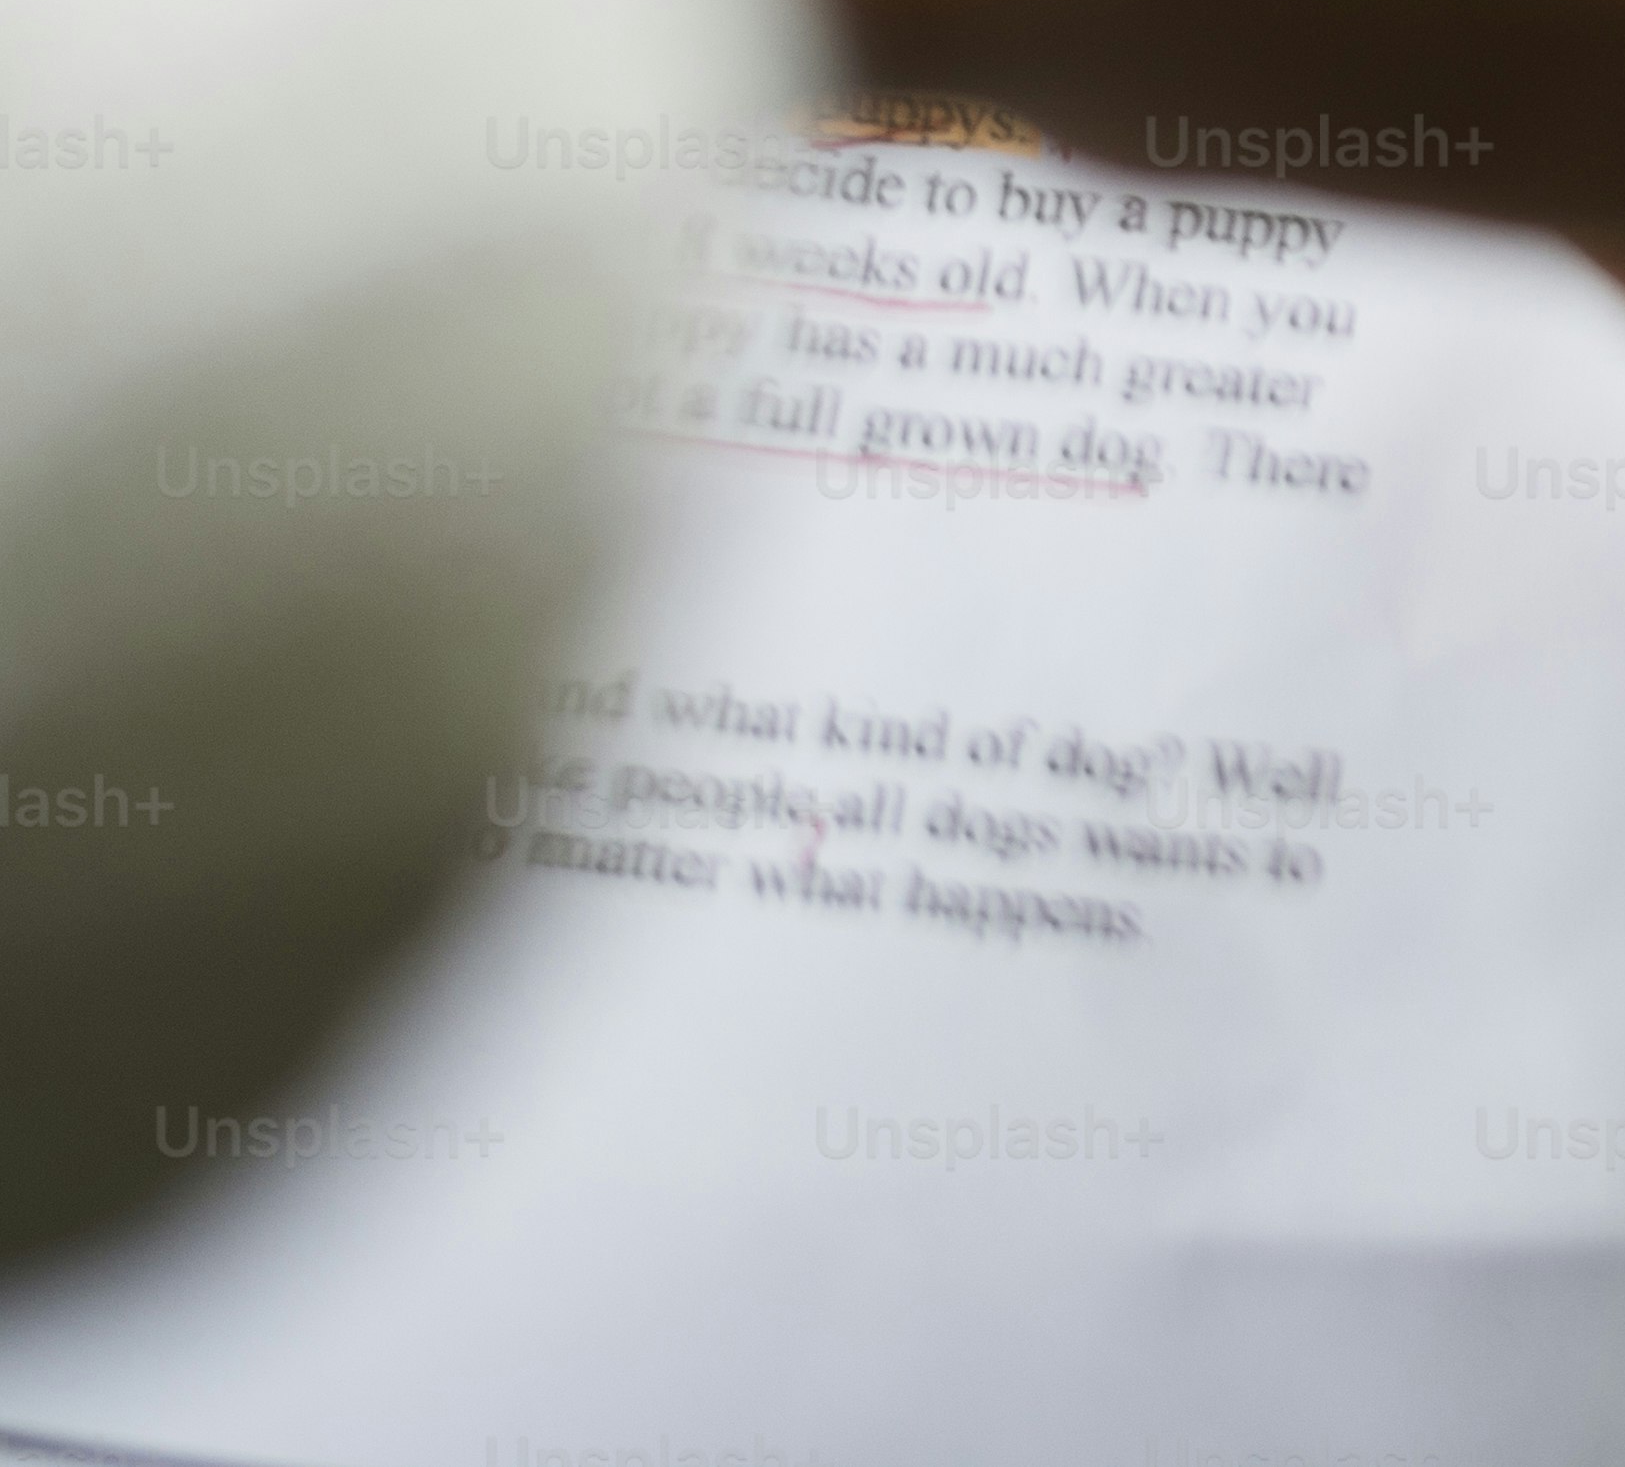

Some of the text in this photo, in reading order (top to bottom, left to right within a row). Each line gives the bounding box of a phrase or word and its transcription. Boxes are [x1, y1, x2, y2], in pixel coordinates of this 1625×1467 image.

[997, 168, 1346, 264] buy puppy
[1068, 250, 1358, 340] When you
[948, 332, 1323, 414] much greater
[858, 399, 1372, 496] grown There
[659, 680, 1344, 807] what kind Well
[831, 777, 907, 836] all
[923, 793, 1061, 856] dogs
[745, 852, 884, 912] what
